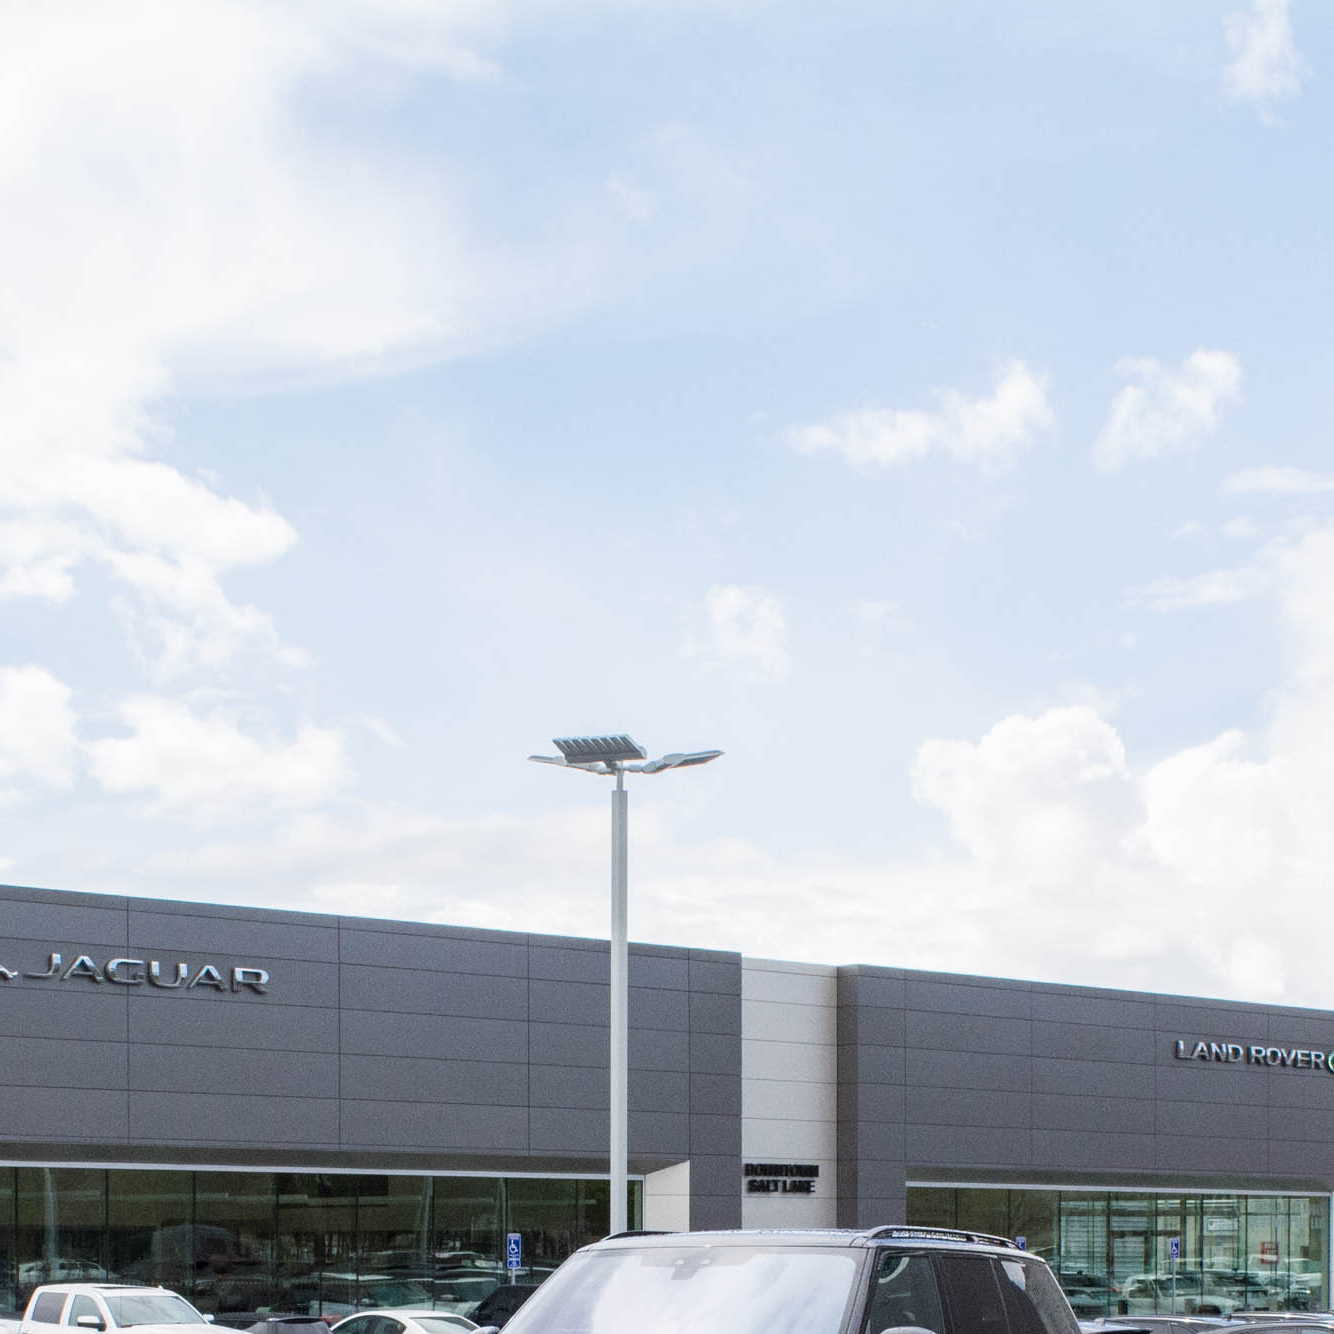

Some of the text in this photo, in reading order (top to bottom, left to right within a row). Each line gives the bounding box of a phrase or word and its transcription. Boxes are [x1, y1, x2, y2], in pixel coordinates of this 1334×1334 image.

[23, 953, 270, 995] JAGUAR
[1175, 1040, 1326, 1069] LAND ROVER
